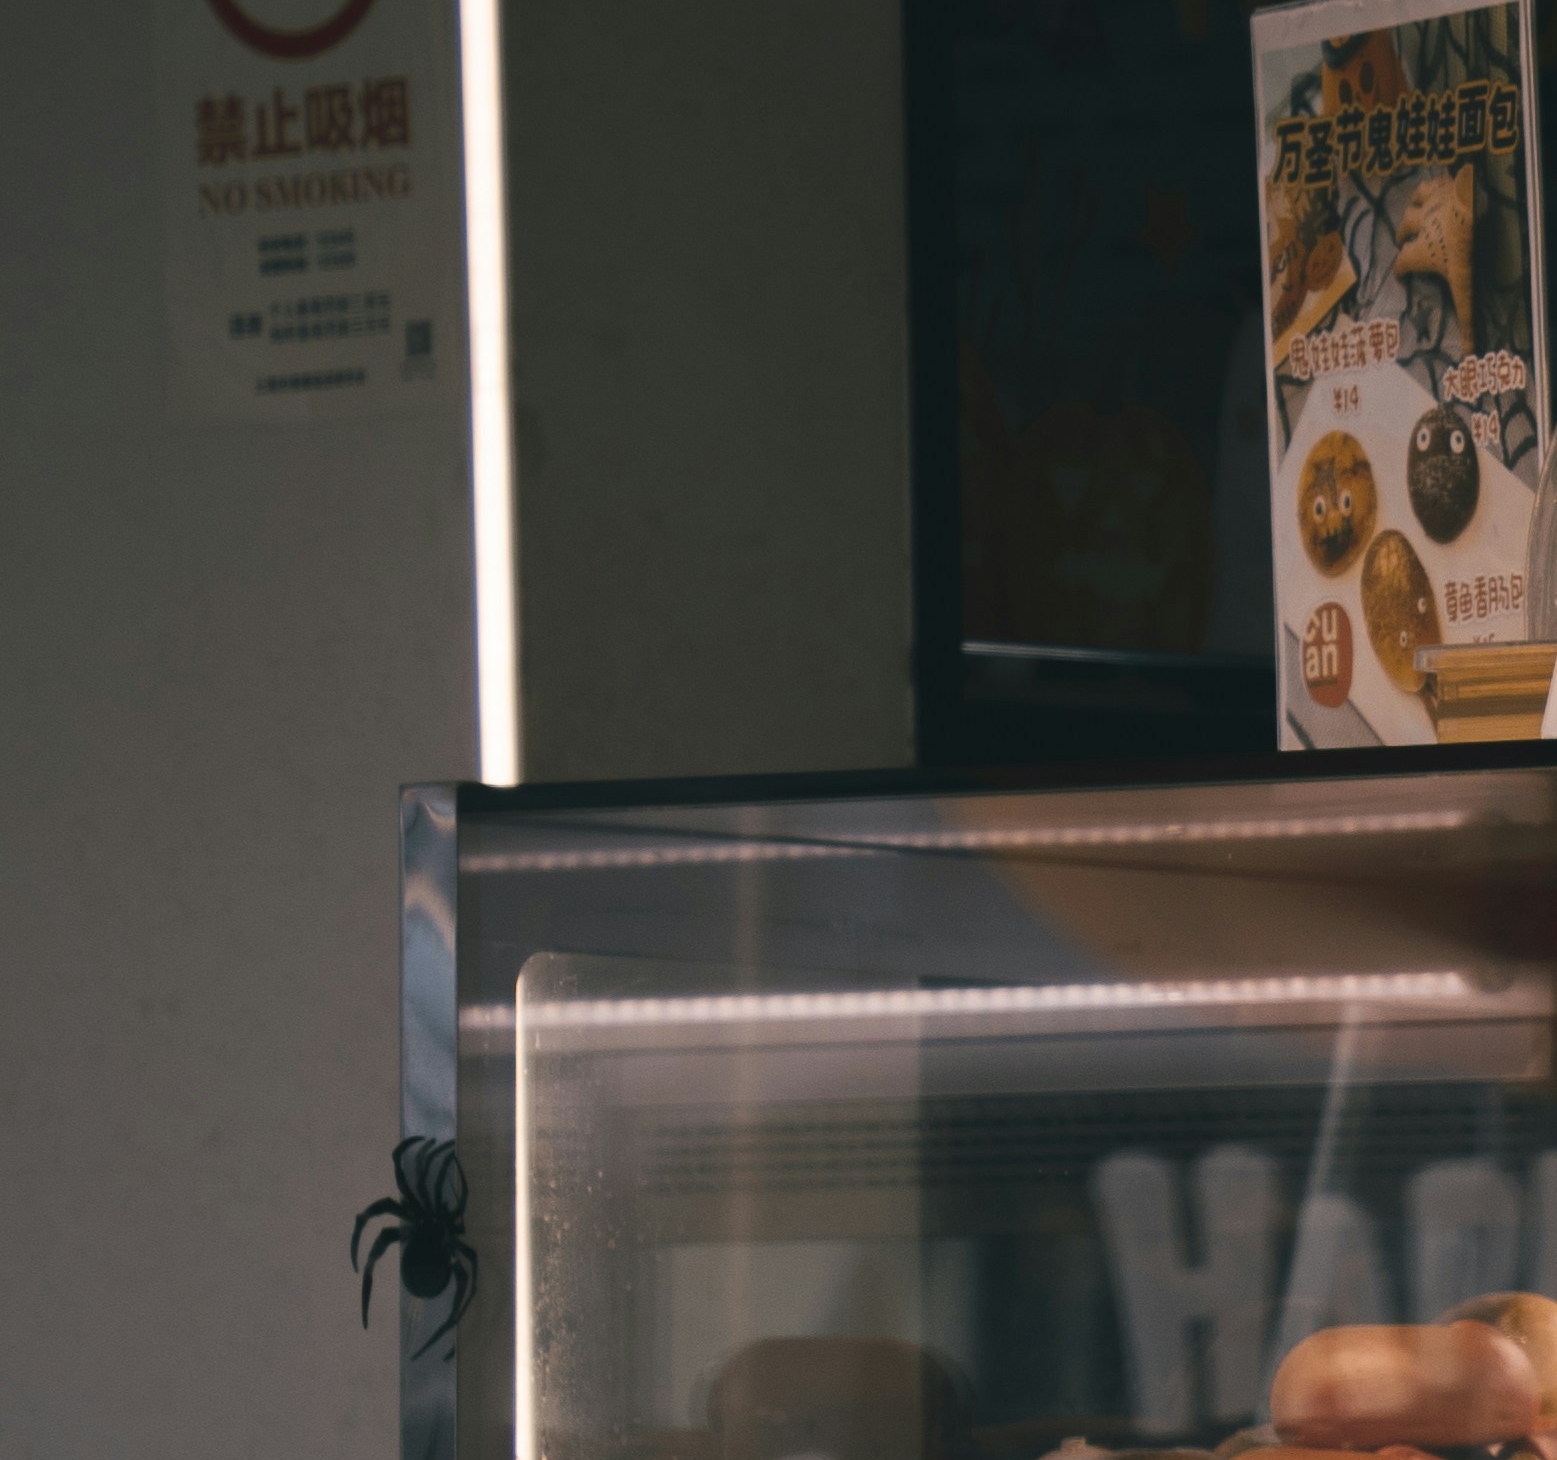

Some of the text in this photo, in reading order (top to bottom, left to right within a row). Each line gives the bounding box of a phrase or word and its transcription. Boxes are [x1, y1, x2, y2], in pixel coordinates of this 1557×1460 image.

[194, 76, 409, 168] 禁止吸烟
[1271, 80, 1520, 187] 万圣节鬼娃娃面包
[198, 163, 410, 218] NO SMOKING
[1333, 385, 1359, 413] ¥14
[1444, 352, 1526, 402] 大眼巧克力
[1472, 414, 1500, 442] ¥14
[1444, 573, 1523, 623] 章鱼香肠包
